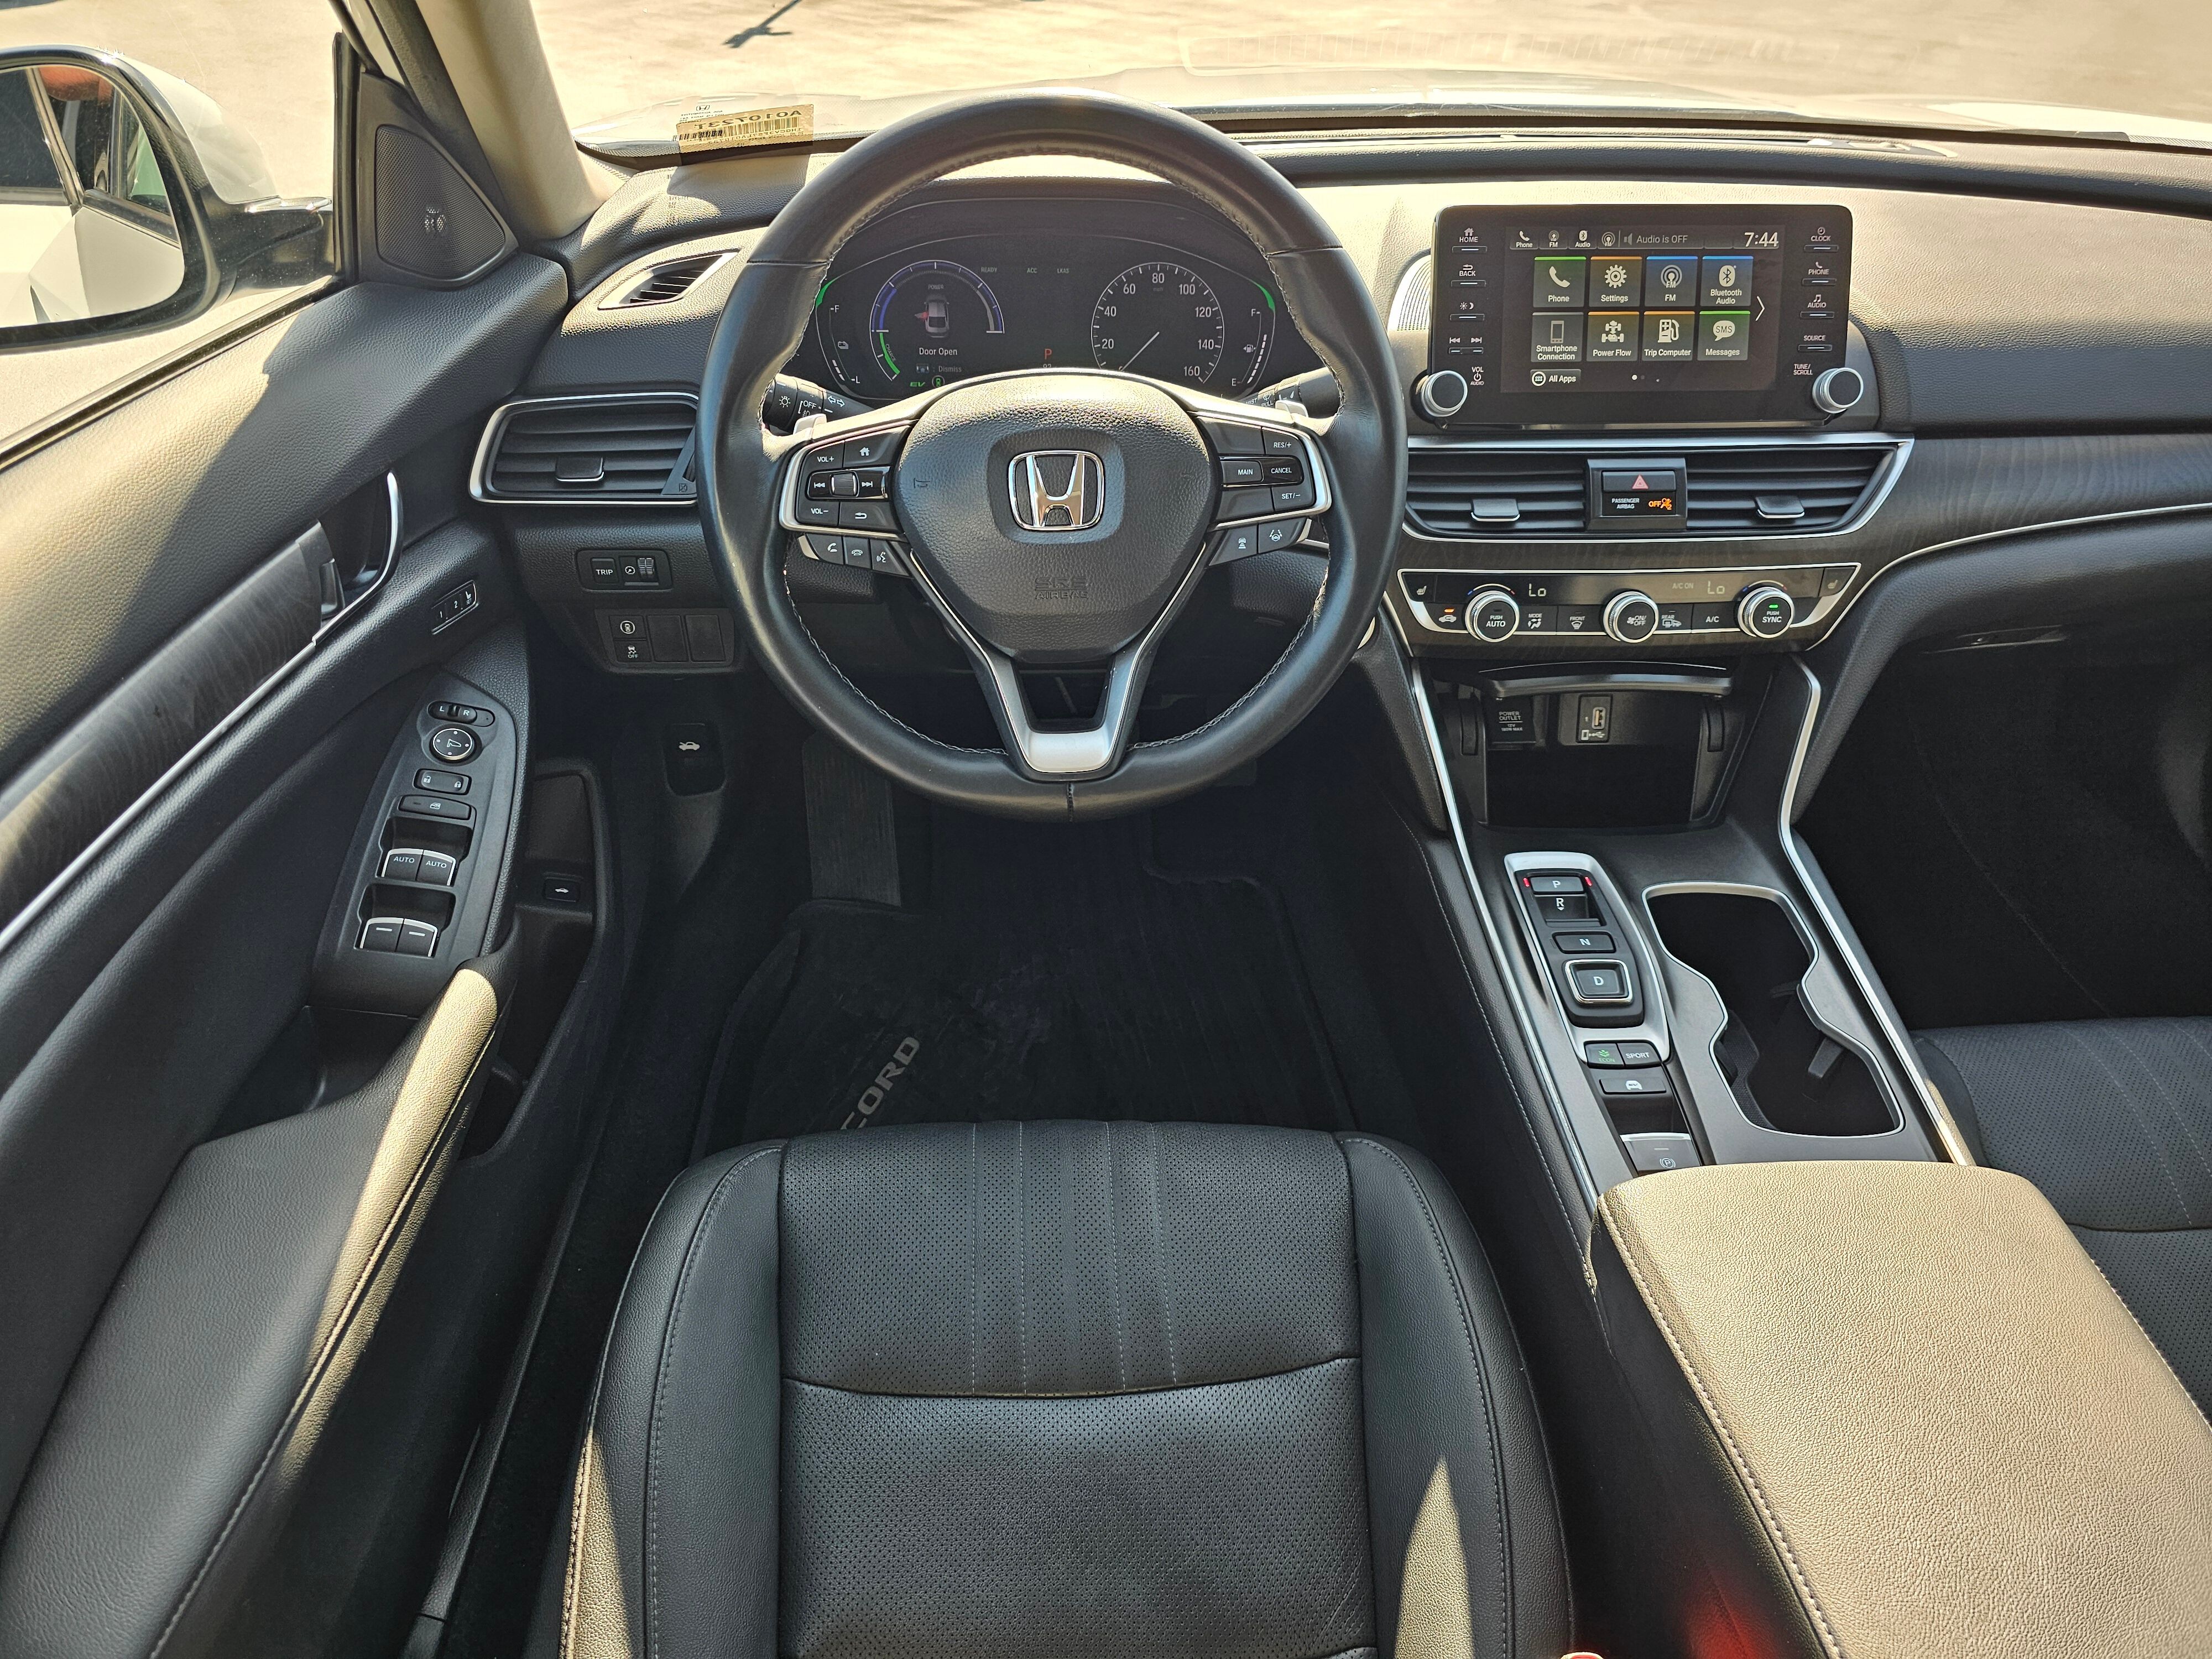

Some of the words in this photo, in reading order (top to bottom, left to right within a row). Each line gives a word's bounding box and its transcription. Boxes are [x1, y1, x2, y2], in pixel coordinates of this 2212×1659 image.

[1636, 235, 1660, 243] Audio
[1671, 235, 1688, 243] OFF
[1744, 232, 1779, 247] 7:44
[1152, 273, 1165, 284] 80
[1123, 283, 1136, 294] 60
[1178, 284, 1196, 295] 100
[1601, 294, 1629, 303] Settings
[834, 305, 839, 313] F
[1104, 306, 1117, 317] 40
[1194, 306, 1212, 317] 120
[1251, 309, 1256, 317] F
[1102, 338, 1114, 349] 20
[1198, 339, 1214, 350] 140
[919, 347, 937, 356] Door
[938, 347, 958, 356] Open
[1044, 348, 1052, 359] P
[1536, 345, 1578, 353] Smartphone
[1644, 348, 1657, 357] Trip
[1658, 348, 1692, 357] Computer
[1705, 348, 1740, 357] Messages
[1183, 366, 1200, 377] 160
[855, 375, 860, 384] L
[1232, 378, 1237, 387] E
[1558, 375, 1577, 384] Apps
[803, 400, 817, 409] OFF
[1528, 583, 1547, 597] Lo
[1707, 581, 1725, 594] Lo
[1035, 591, 1089, 600] AIRBAG
[454, 601, 458, 609] 2
[425, 860, 447, 869] AUTO
[1556, 898, 1564, 907] R
[1593, 976, 1604, 985] D
